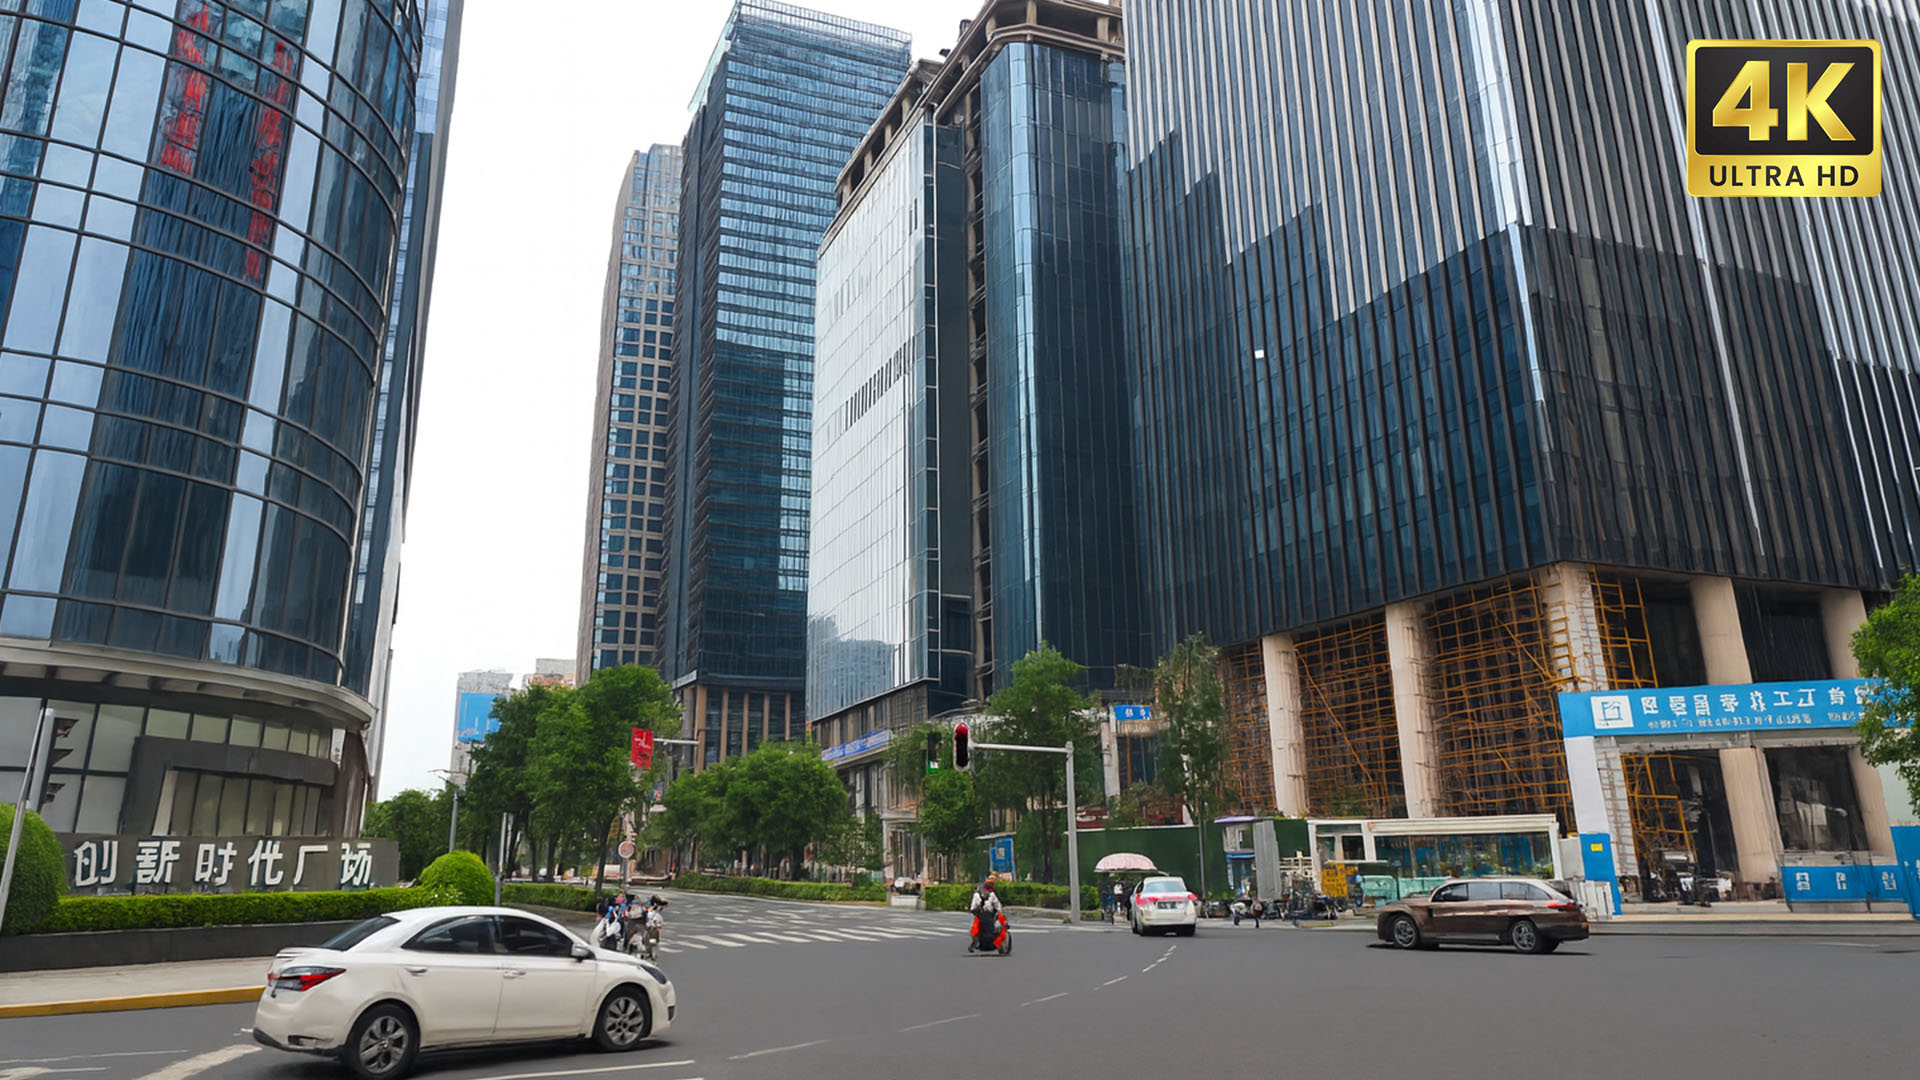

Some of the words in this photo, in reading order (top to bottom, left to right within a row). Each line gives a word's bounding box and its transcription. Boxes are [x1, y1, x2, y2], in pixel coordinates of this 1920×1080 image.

[74, 840, 372, 887] 创新时代广场
